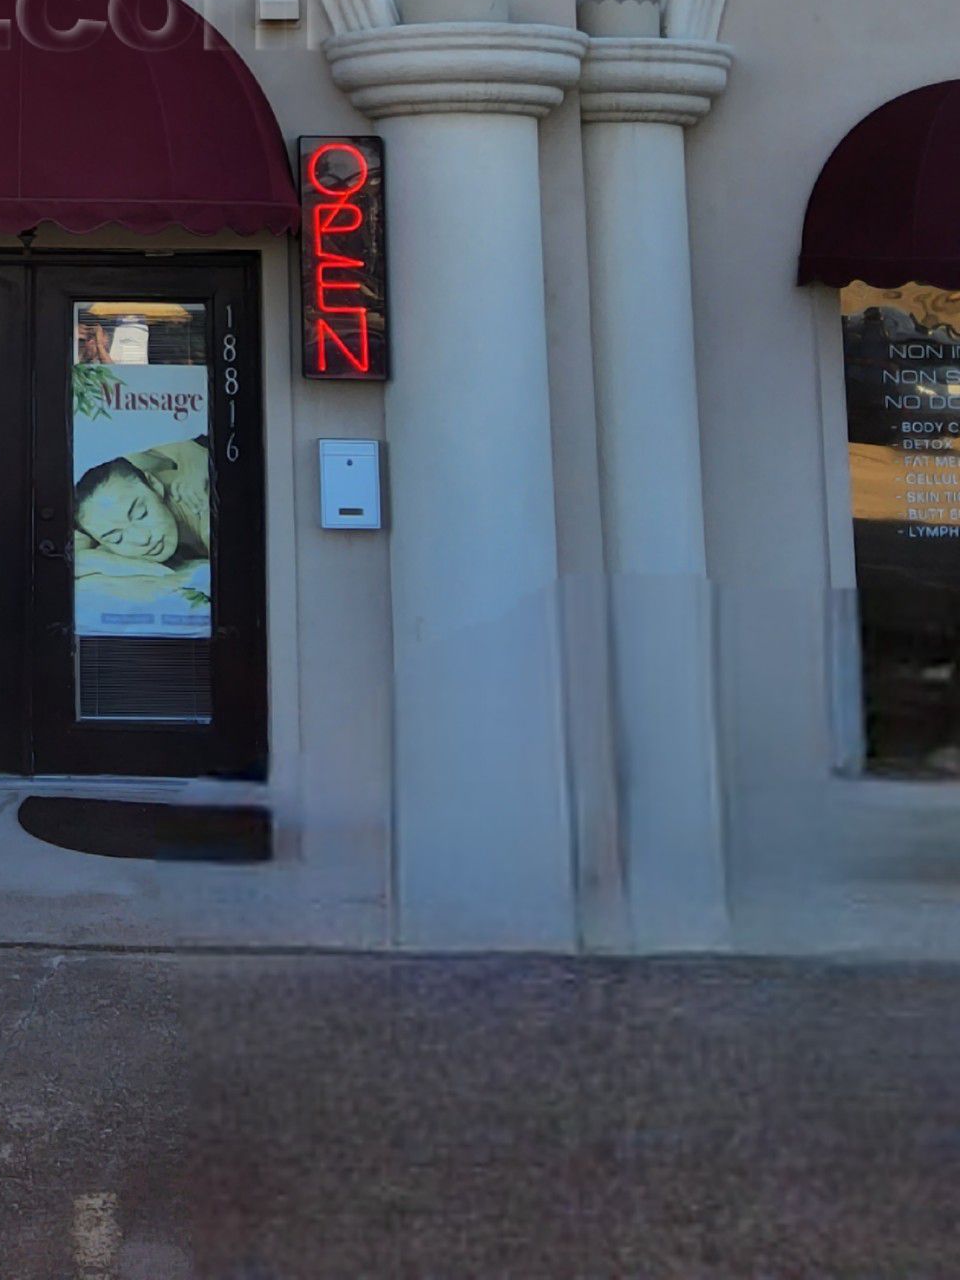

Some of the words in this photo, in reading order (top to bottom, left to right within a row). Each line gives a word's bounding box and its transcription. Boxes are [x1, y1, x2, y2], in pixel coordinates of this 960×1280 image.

[307, 142, 369, 373] OPEN
[888, 344, 944, 359] NON
[951, 344, 960, 359] I
[222, 304, 239, 463] 18816
[882, 369, 937, 385] NON
[101, 382, 204, 421] Massage
[884, 395, 921, 410] NO
[901, 421, 944, 434] BODY
[903, 439, 953, 450] DETOX
[904, 456, 930, 467] FAT
[907, 491, 940, 504] SKIN
[908, 508, 945, 521] BUTT
[909, 526, 960, 538] LYMPH
